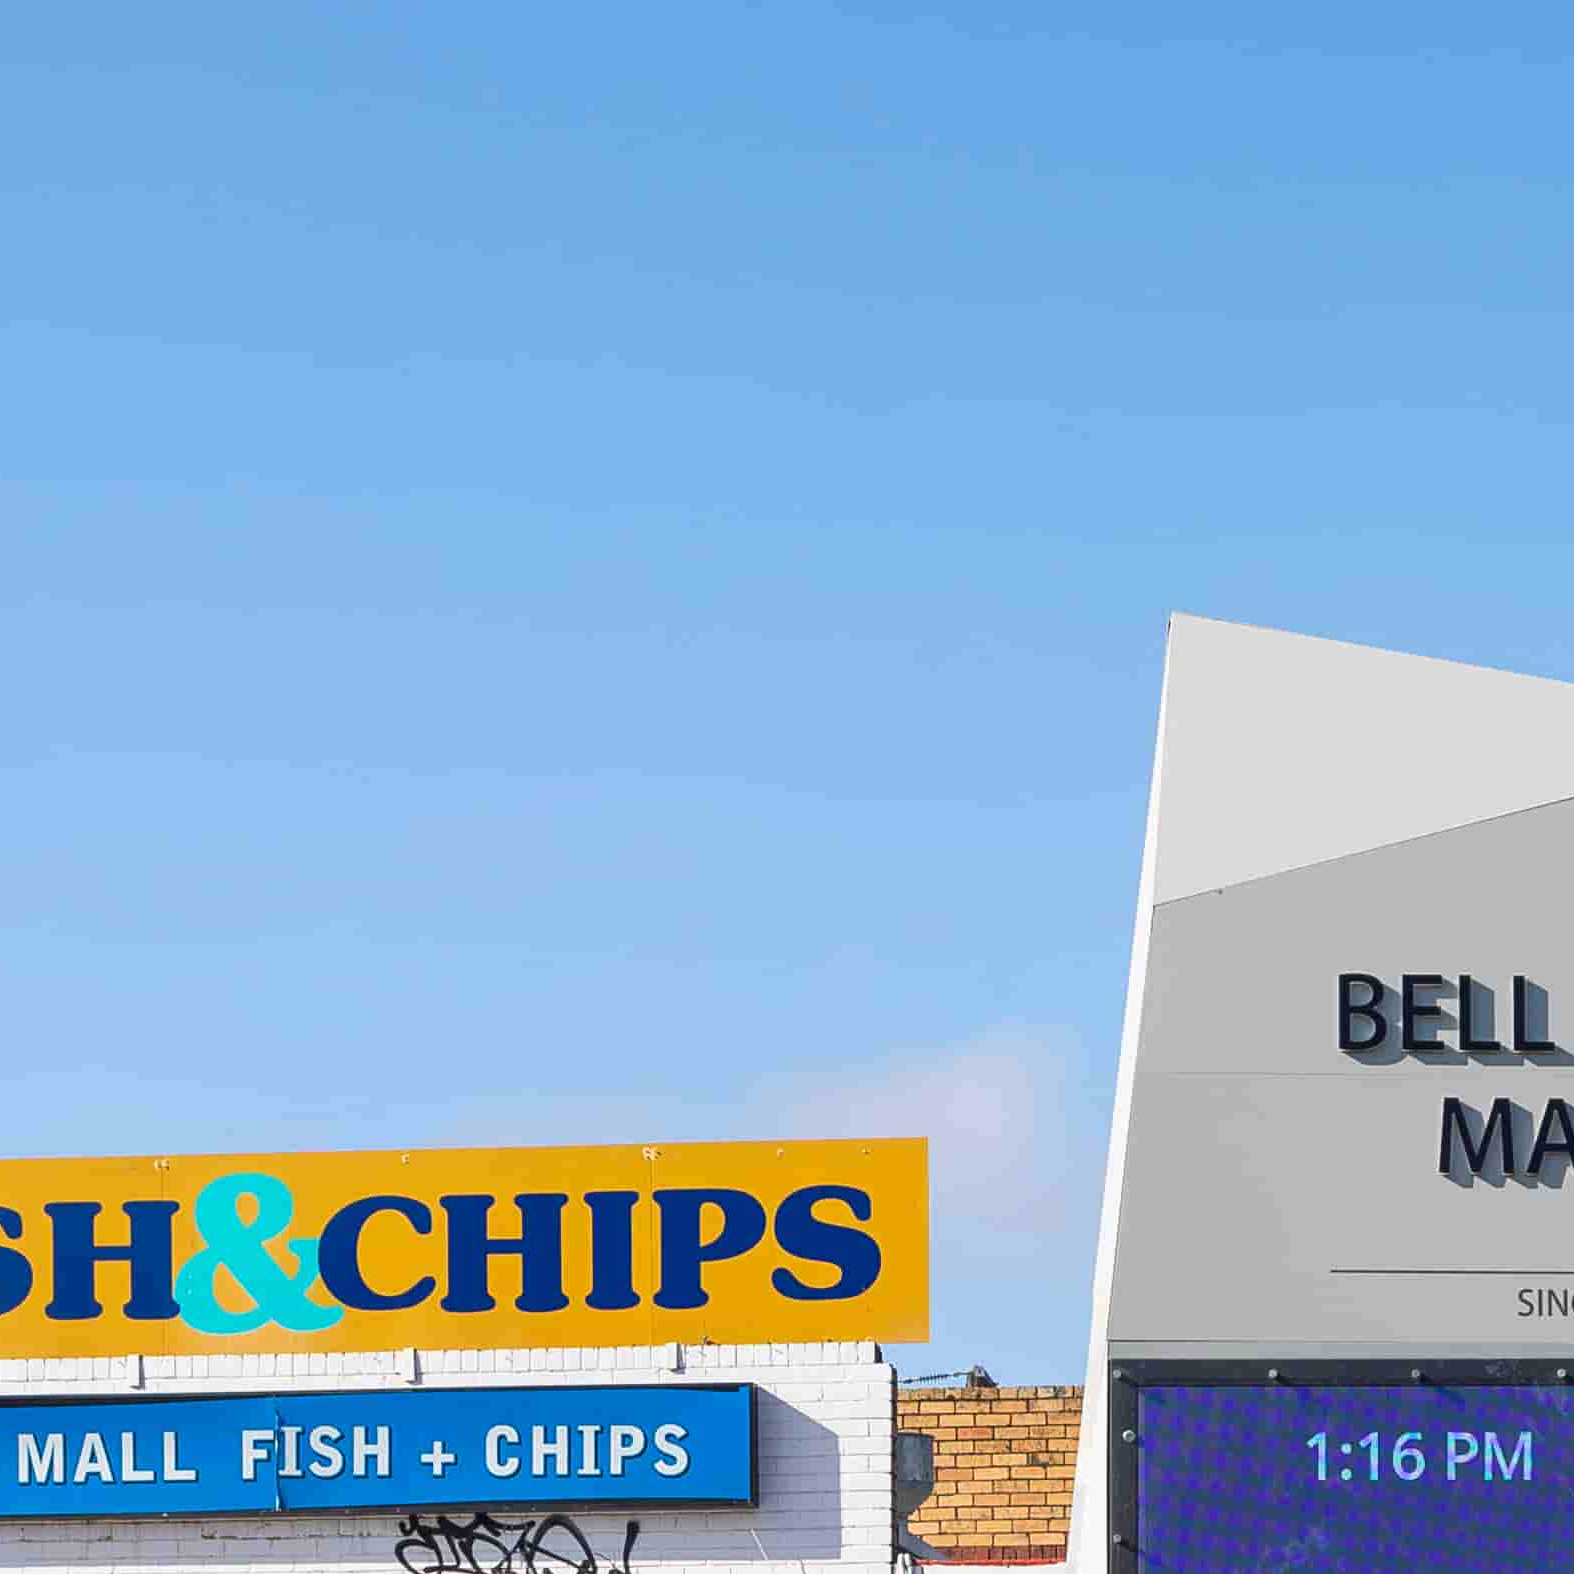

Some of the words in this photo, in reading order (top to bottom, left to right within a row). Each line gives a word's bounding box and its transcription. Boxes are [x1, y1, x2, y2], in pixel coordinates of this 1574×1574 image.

[1336, 973, 1558, 1053] BELL
[17, 1429, 199, 1484] MALL
[241, 1424, 393, 1482] FISH
[420, 1440, 457, 1477] +
[484, 1423, 692, 1479] CHIPS
[1306, 1431, 1427, 1481] 1:16
[1447, 1431, 1534, 1481] PM
